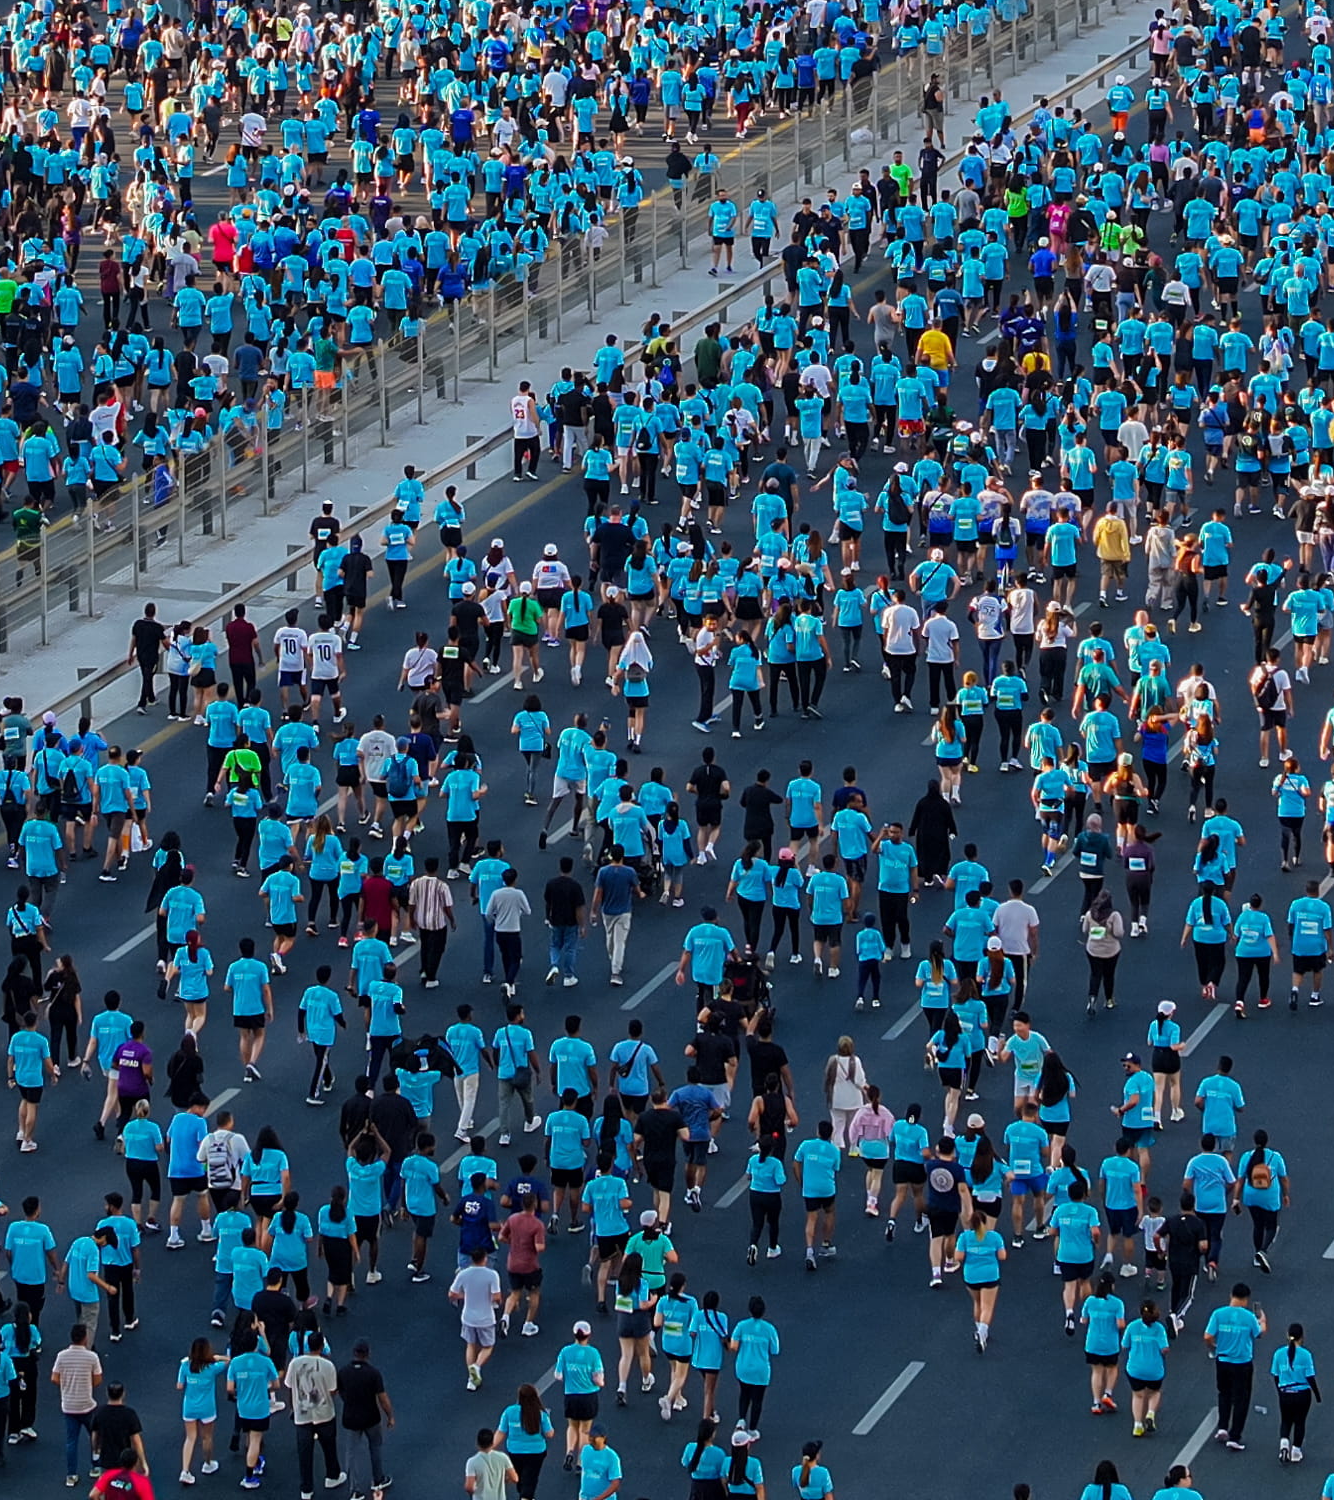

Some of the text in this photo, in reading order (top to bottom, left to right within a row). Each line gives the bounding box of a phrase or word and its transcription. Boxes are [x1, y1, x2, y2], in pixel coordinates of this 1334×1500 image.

[514, 408, 525, 419] 23
[283, 638, 296, 656] 10
[317, 644, 331, 662] 10
